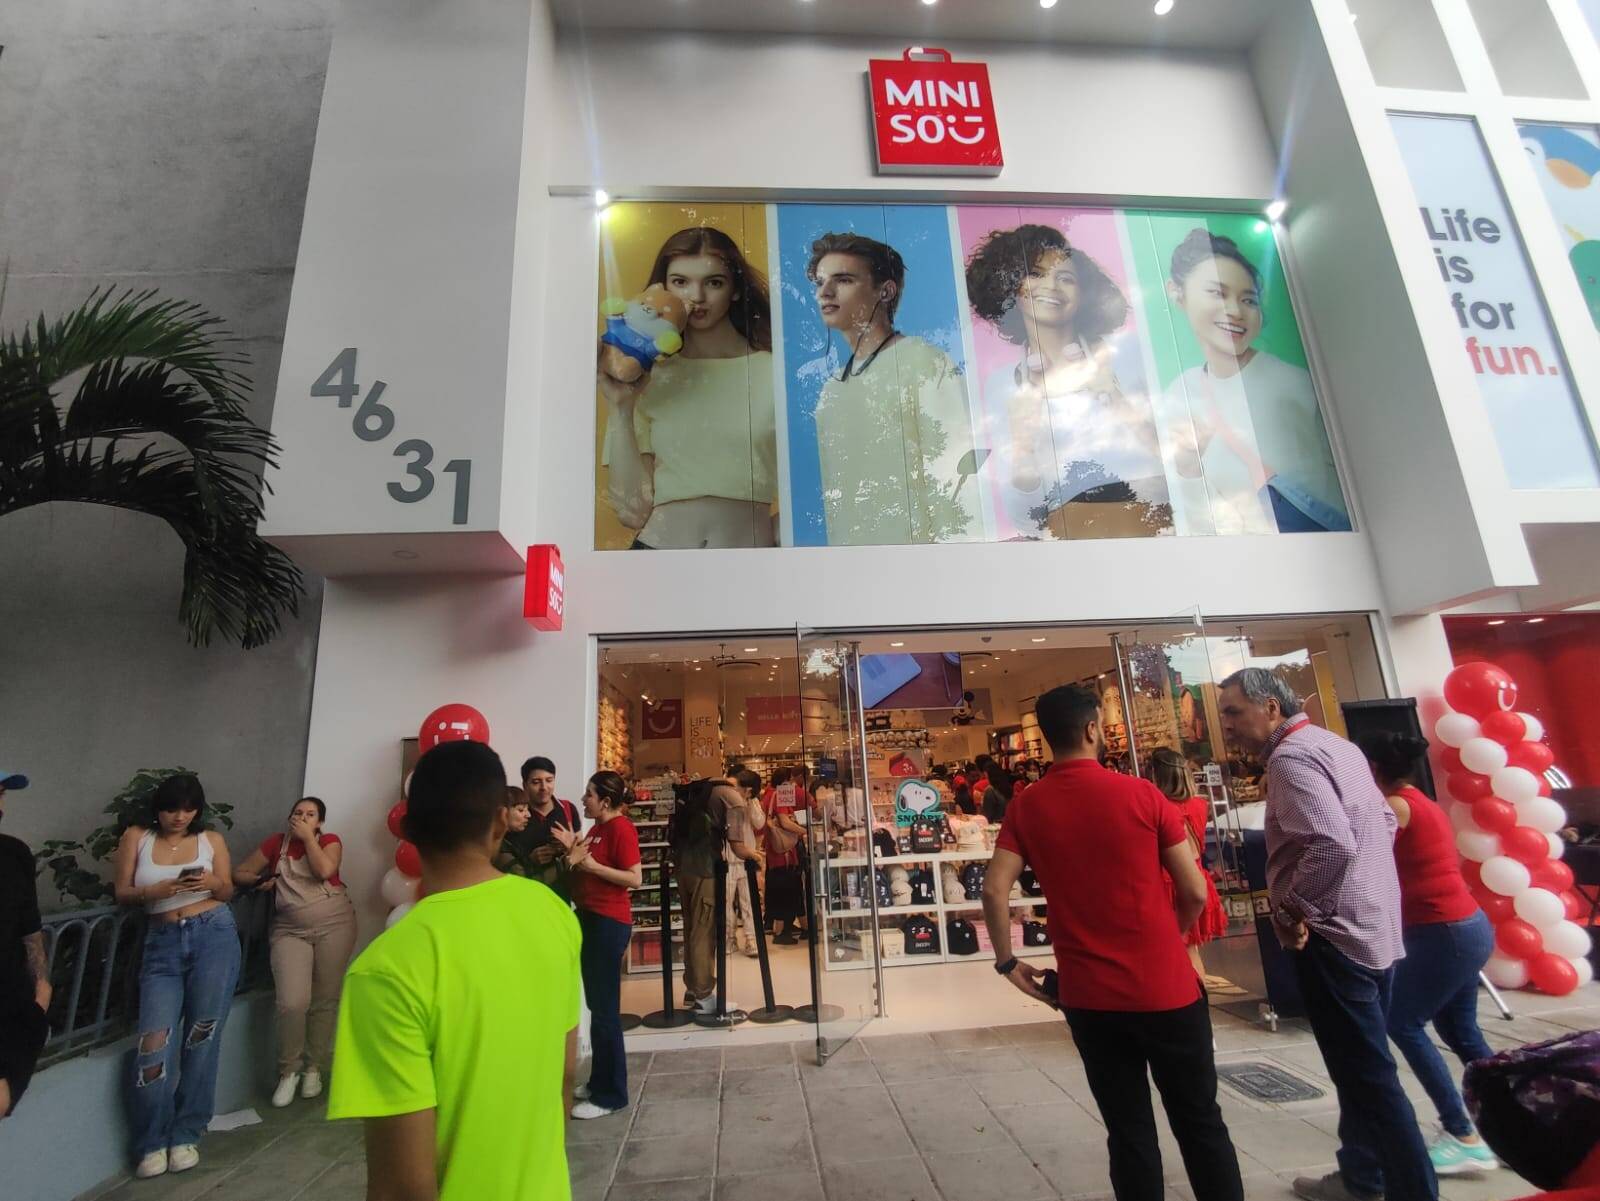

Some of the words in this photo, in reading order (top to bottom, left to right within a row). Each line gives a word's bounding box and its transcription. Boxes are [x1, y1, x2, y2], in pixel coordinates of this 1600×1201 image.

[885, 79, 981, 108] MINI
[1419, 207, 1501, 243] Life
[1433, 248, 1474, 283] is
[1451, 292, 1516, 330] for
[1465, 336, 1559, 376] fun.
[310, 348, 472, 525] 4631
[690, 716, 711, 727] LIFE
[690, 727, 700, 737] IS
[690, 737, 713, 747] FOR
